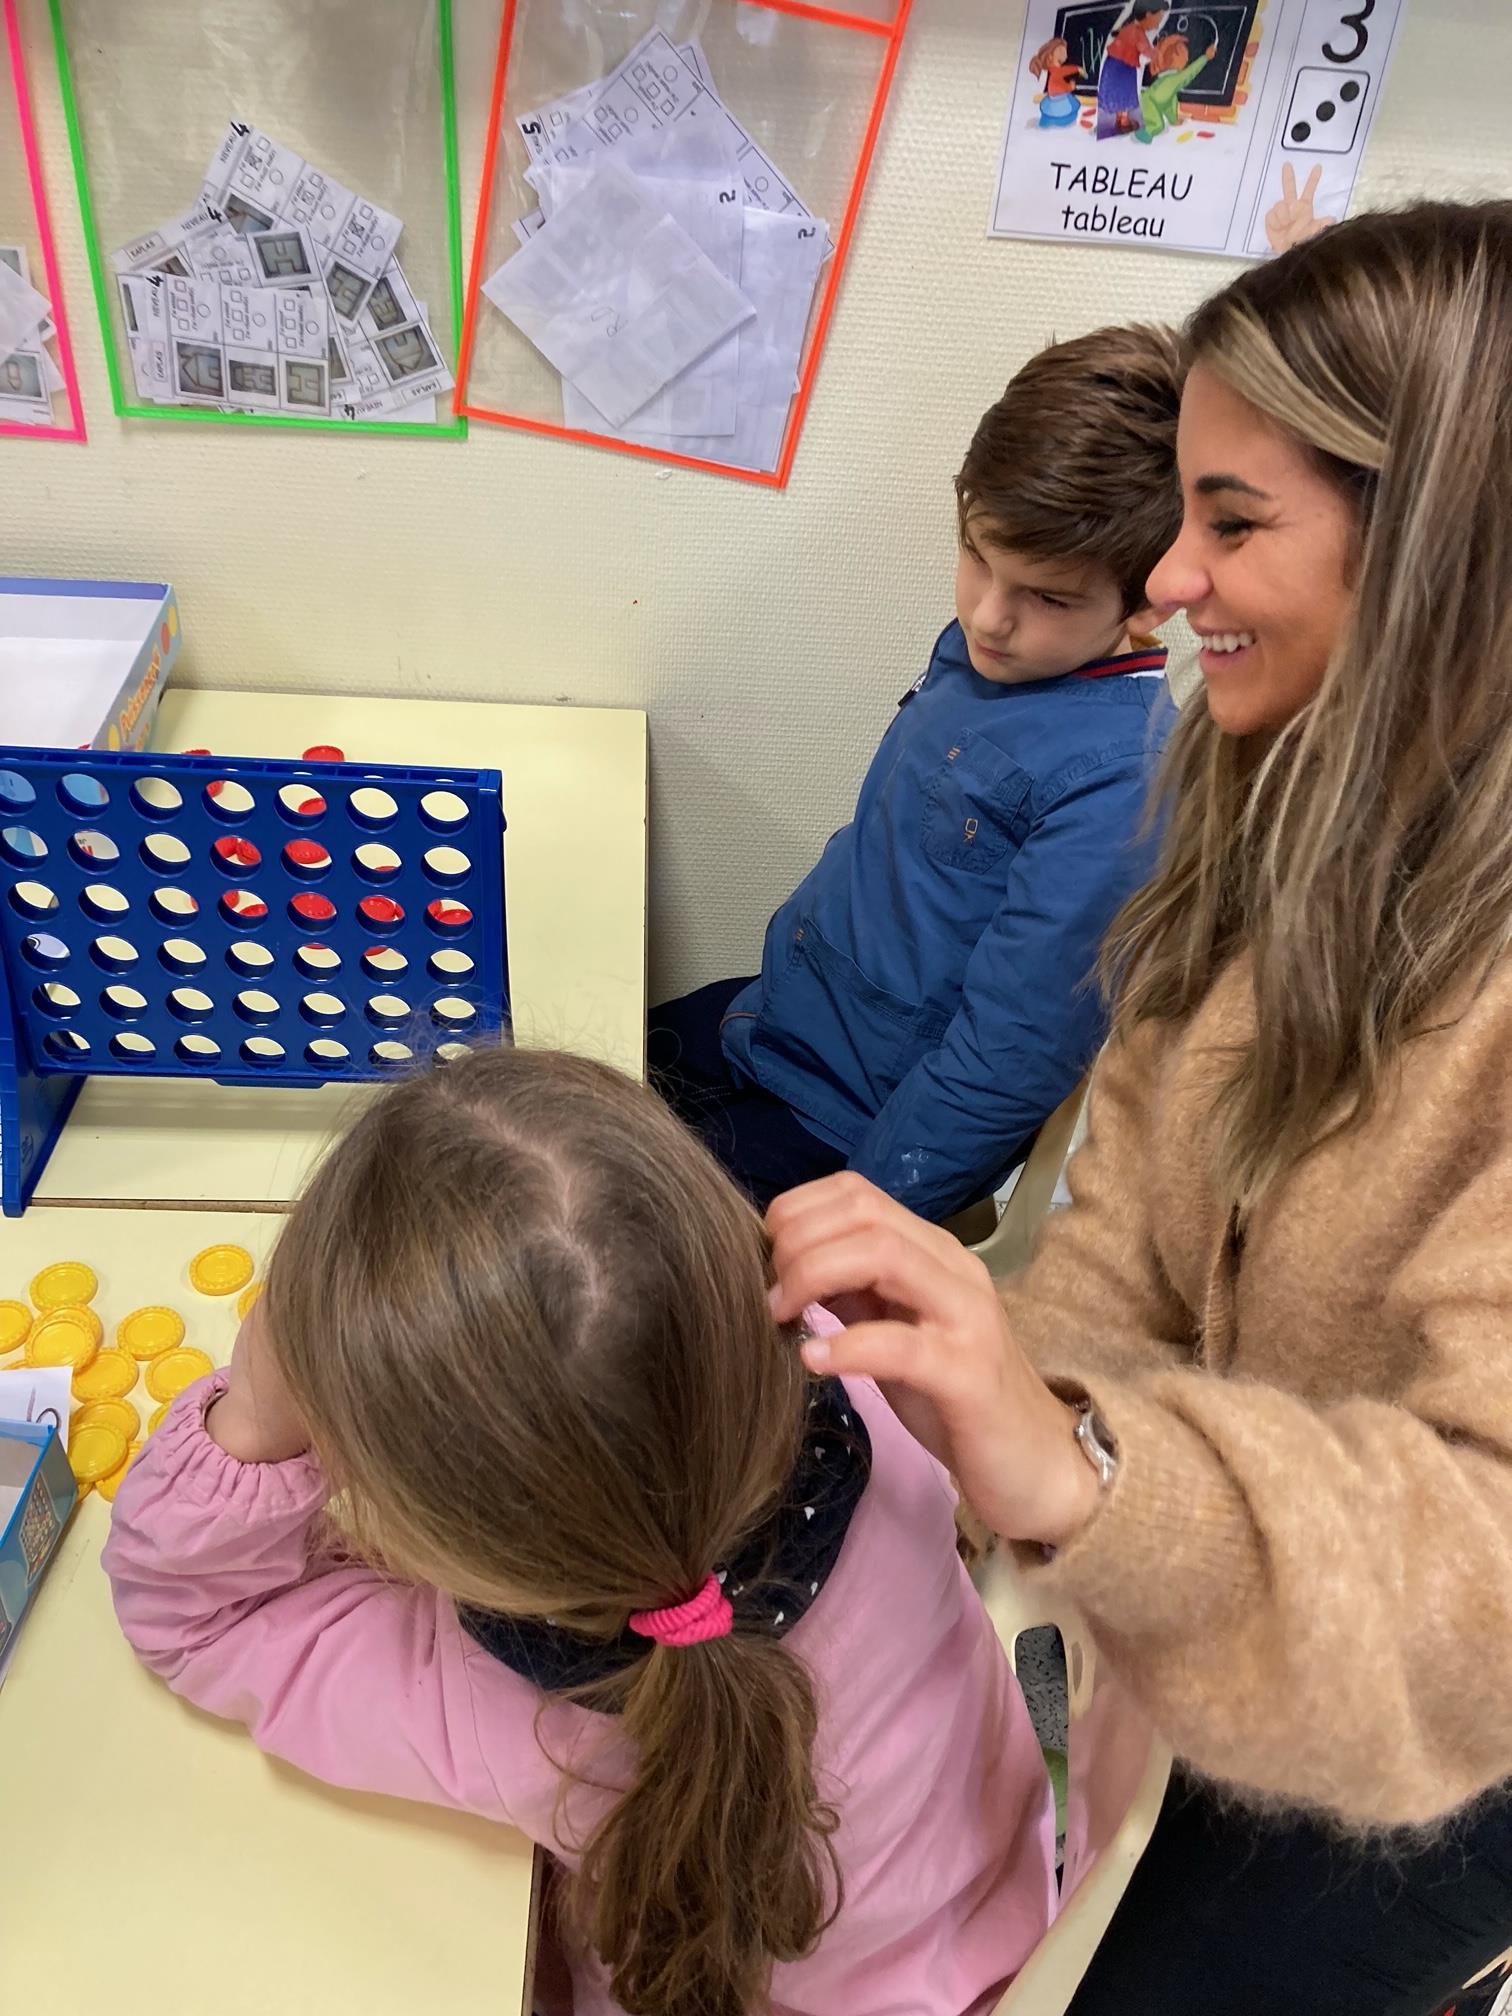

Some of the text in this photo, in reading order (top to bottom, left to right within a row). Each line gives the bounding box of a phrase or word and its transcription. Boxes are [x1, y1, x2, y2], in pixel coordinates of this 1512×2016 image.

[1322, 0, 1375, 63] 3
[230, 120, 250, 137] 4
[521, 121, 541, 134] 5
[1050, 162, 1193, 201] TABLEAU
[203, 198, 223, 223] 4
[1061, 204, 1165, 238] tableau
[146, 275, 164, 288] 4
